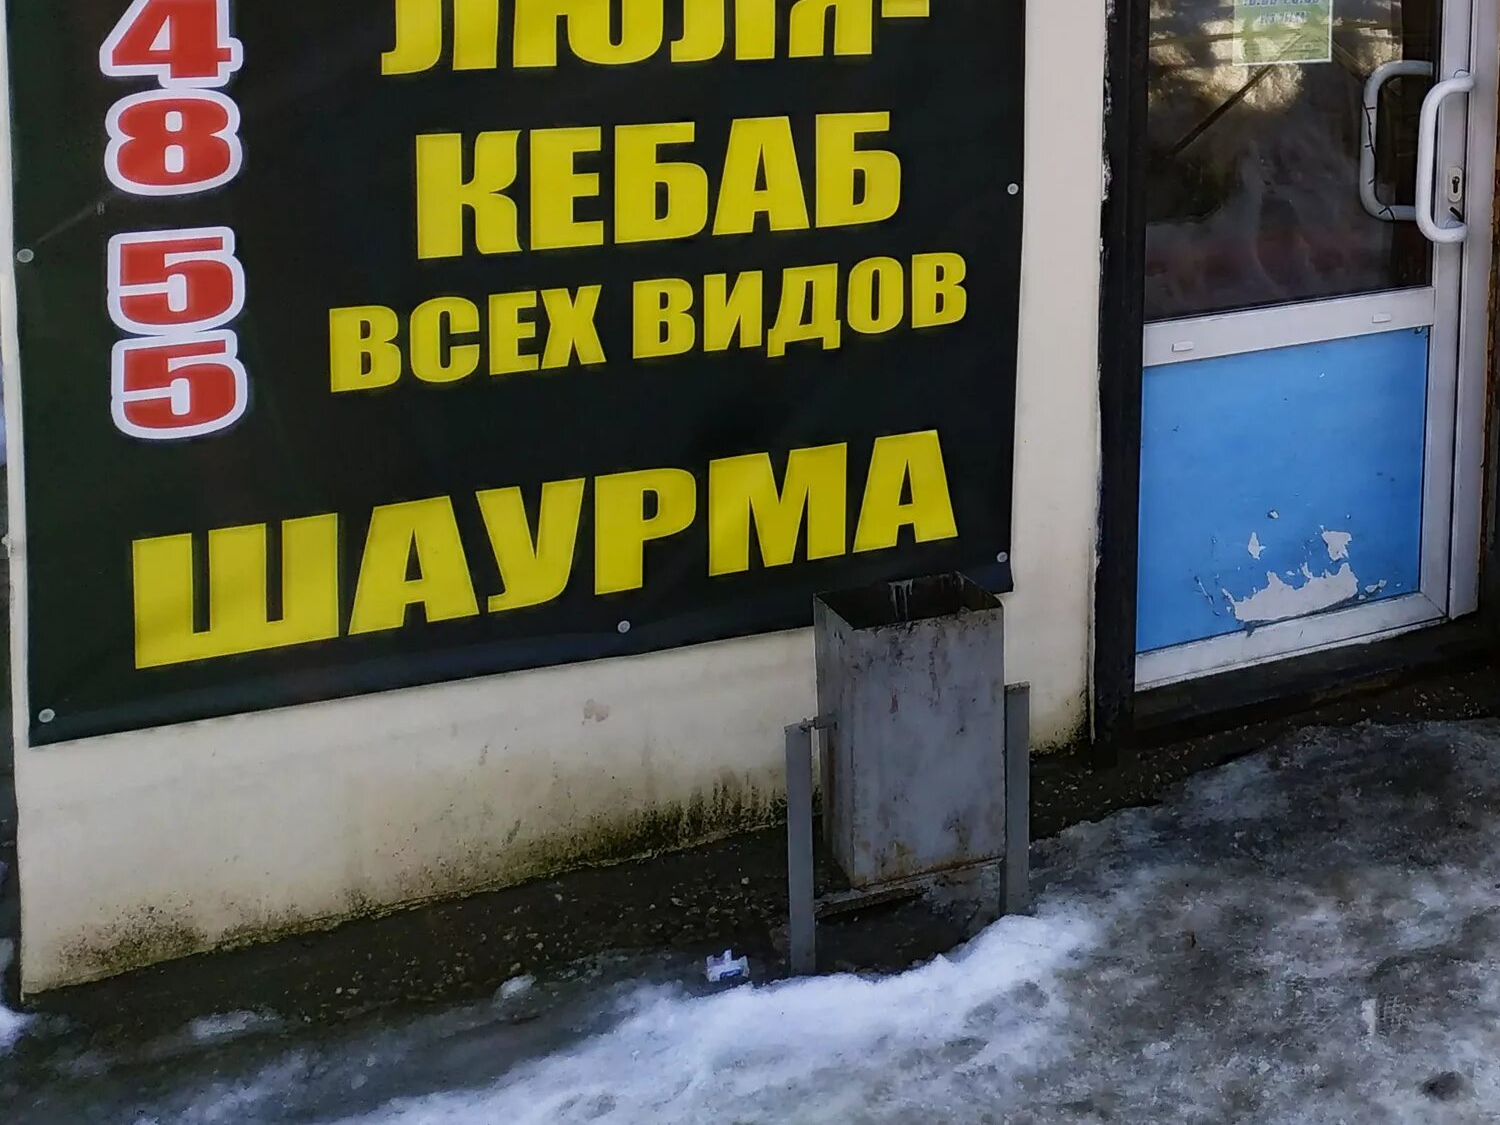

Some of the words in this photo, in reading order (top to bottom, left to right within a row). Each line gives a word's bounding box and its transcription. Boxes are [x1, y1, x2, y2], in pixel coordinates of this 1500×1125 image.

[416, 111, 902, 259] КЕБАБ
[329, 285, 606, 393] ВСЕХ
[632, 252, 968, 358] ВИДОВ
[132, 428, 958, 669] ШАУРМА
